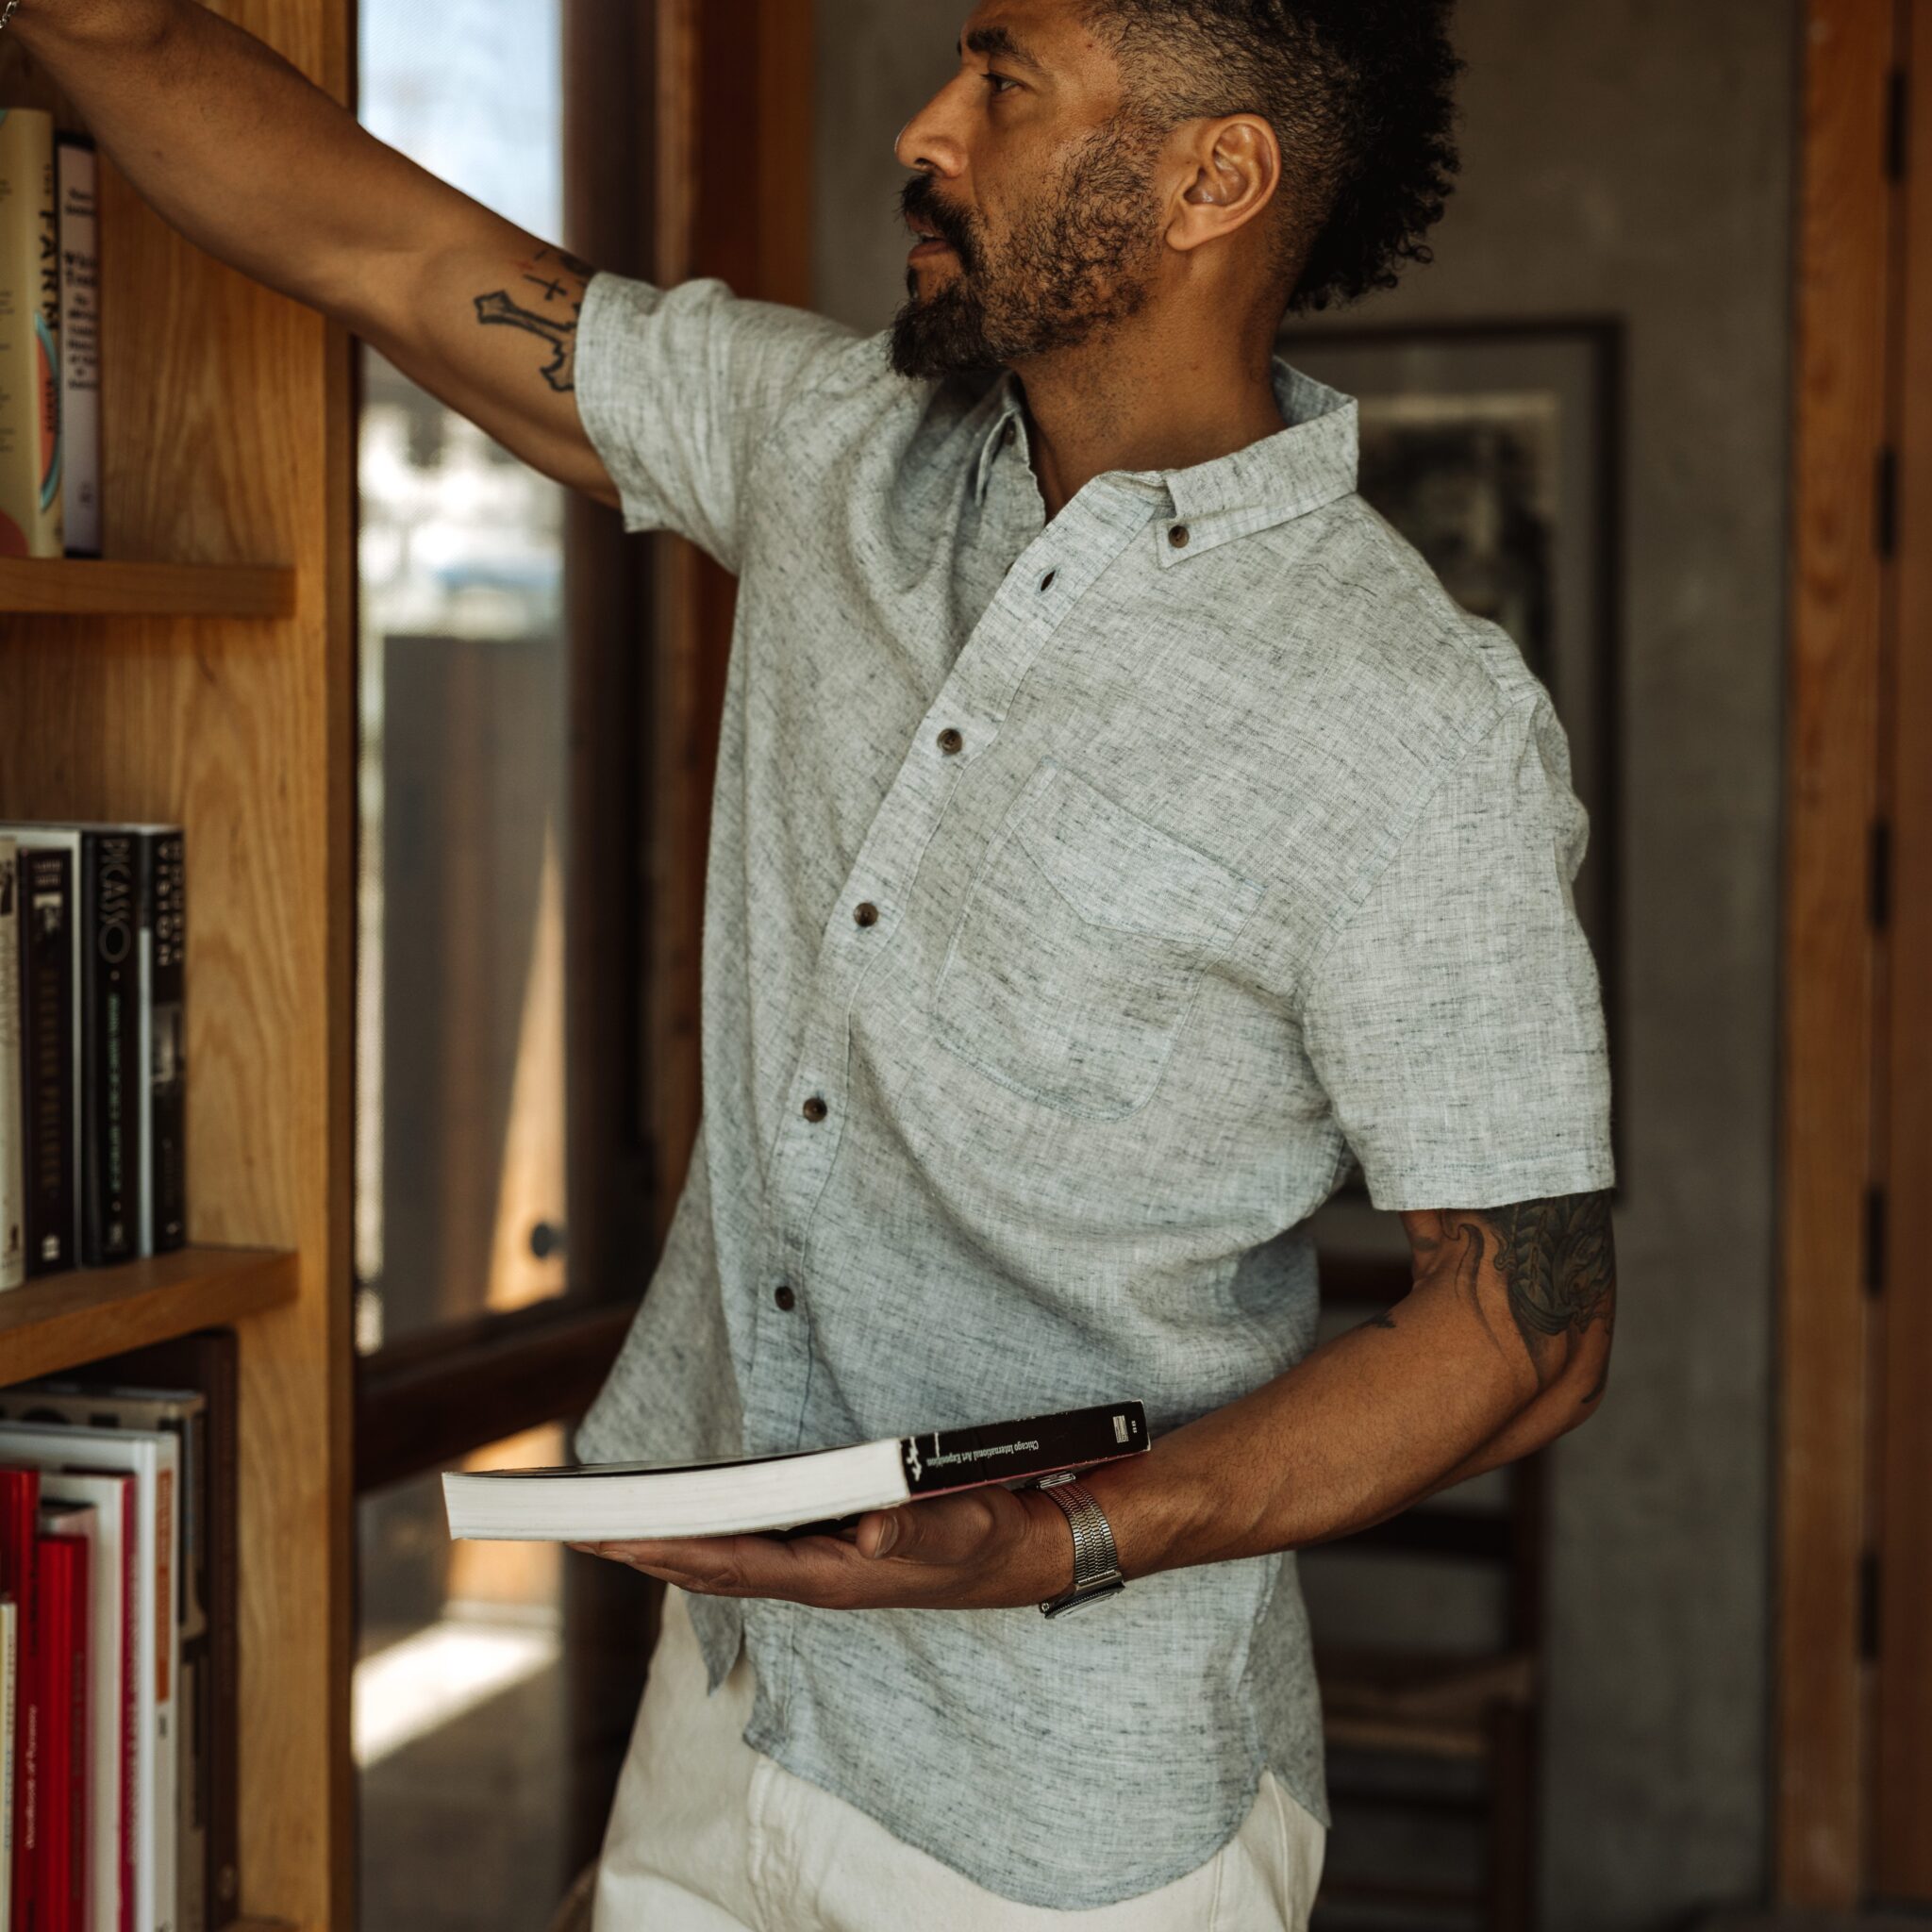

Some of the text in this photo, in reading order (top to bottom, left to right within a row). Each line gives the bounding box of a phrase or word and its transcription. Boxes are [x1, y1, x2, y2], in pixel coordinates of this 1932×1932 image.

[98, 838, 131, 963] PICASSO
[925, 1440, 1040, 1467] Chicago International Art Exposition
